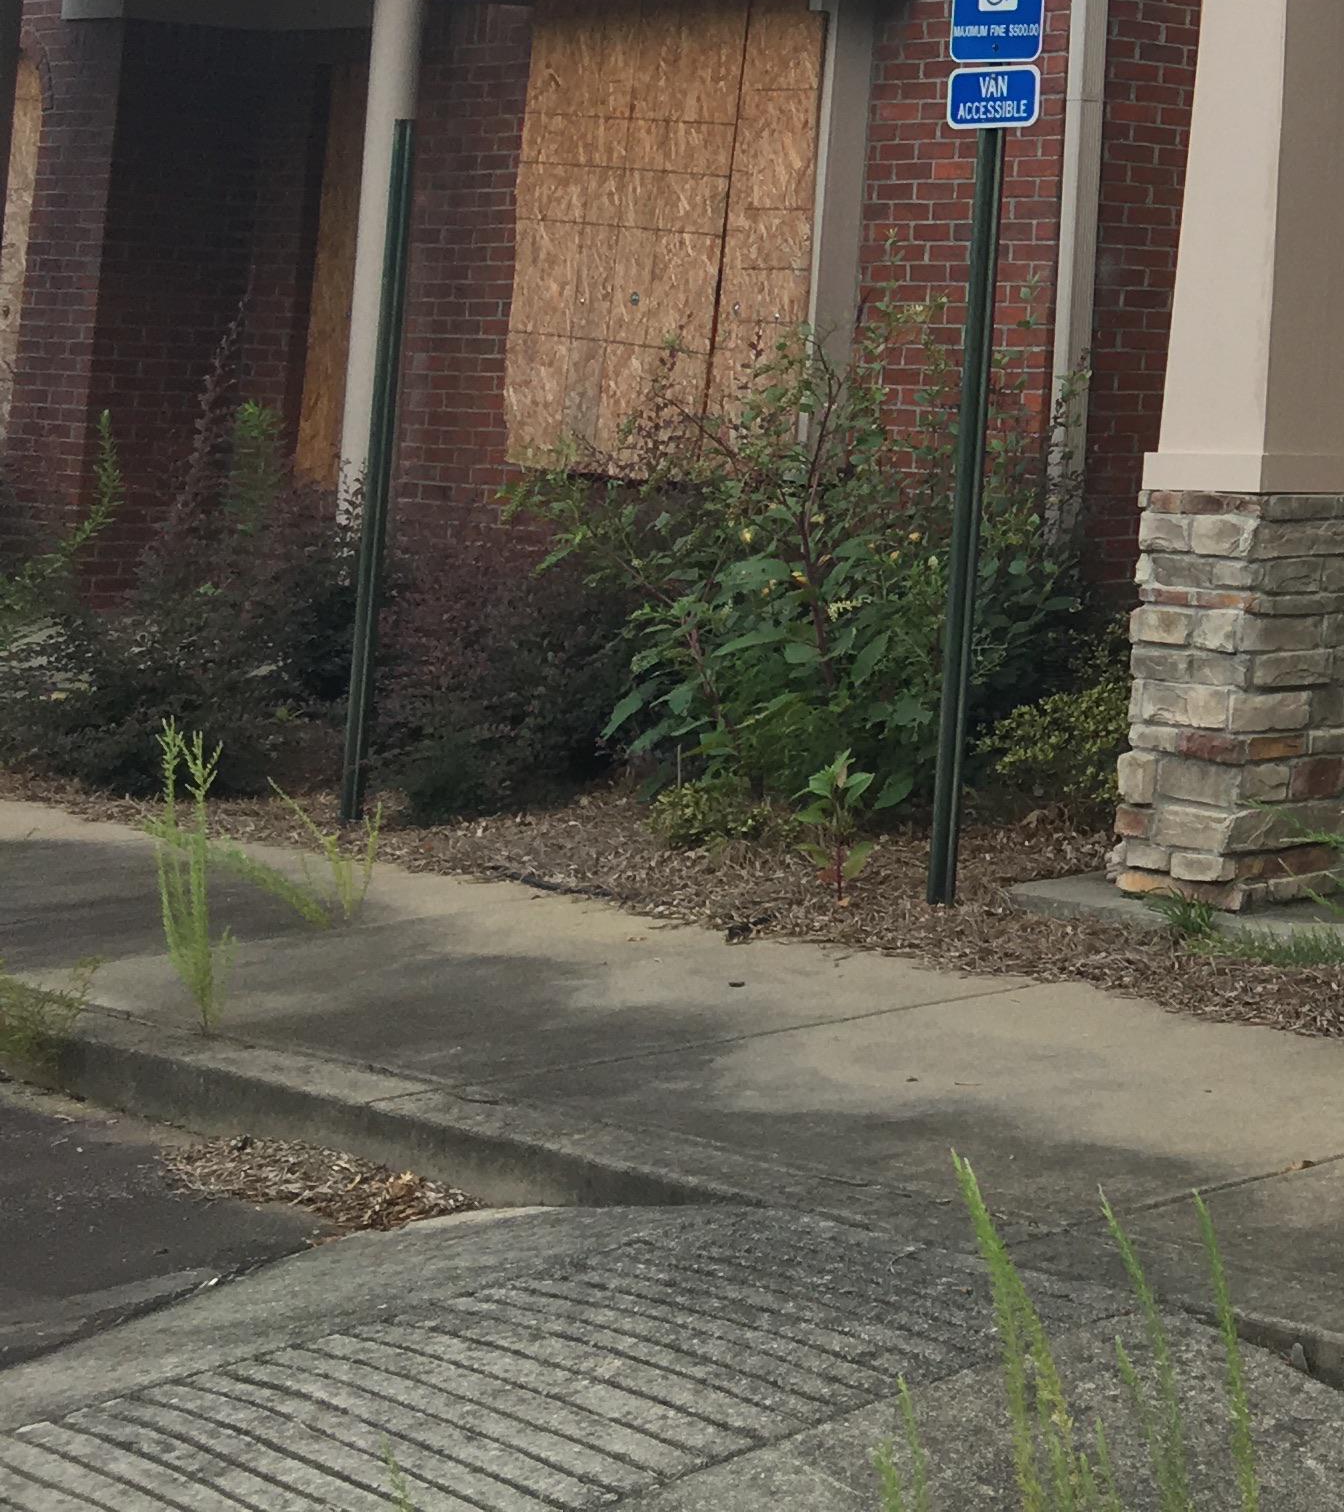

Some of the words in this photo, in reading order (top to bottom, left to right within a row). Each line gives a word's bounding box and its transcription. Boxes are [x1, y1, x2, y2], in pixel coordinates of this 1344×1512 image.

[953, 24, 988, 37] MAXIMUM
[990, 24, 1006, 36] FINE
[1008, 23, 1040, 37] $500.00
[979, 76, 1008, 98] VAN
[957, 99, 1028, 120] ACCESSIBLE
